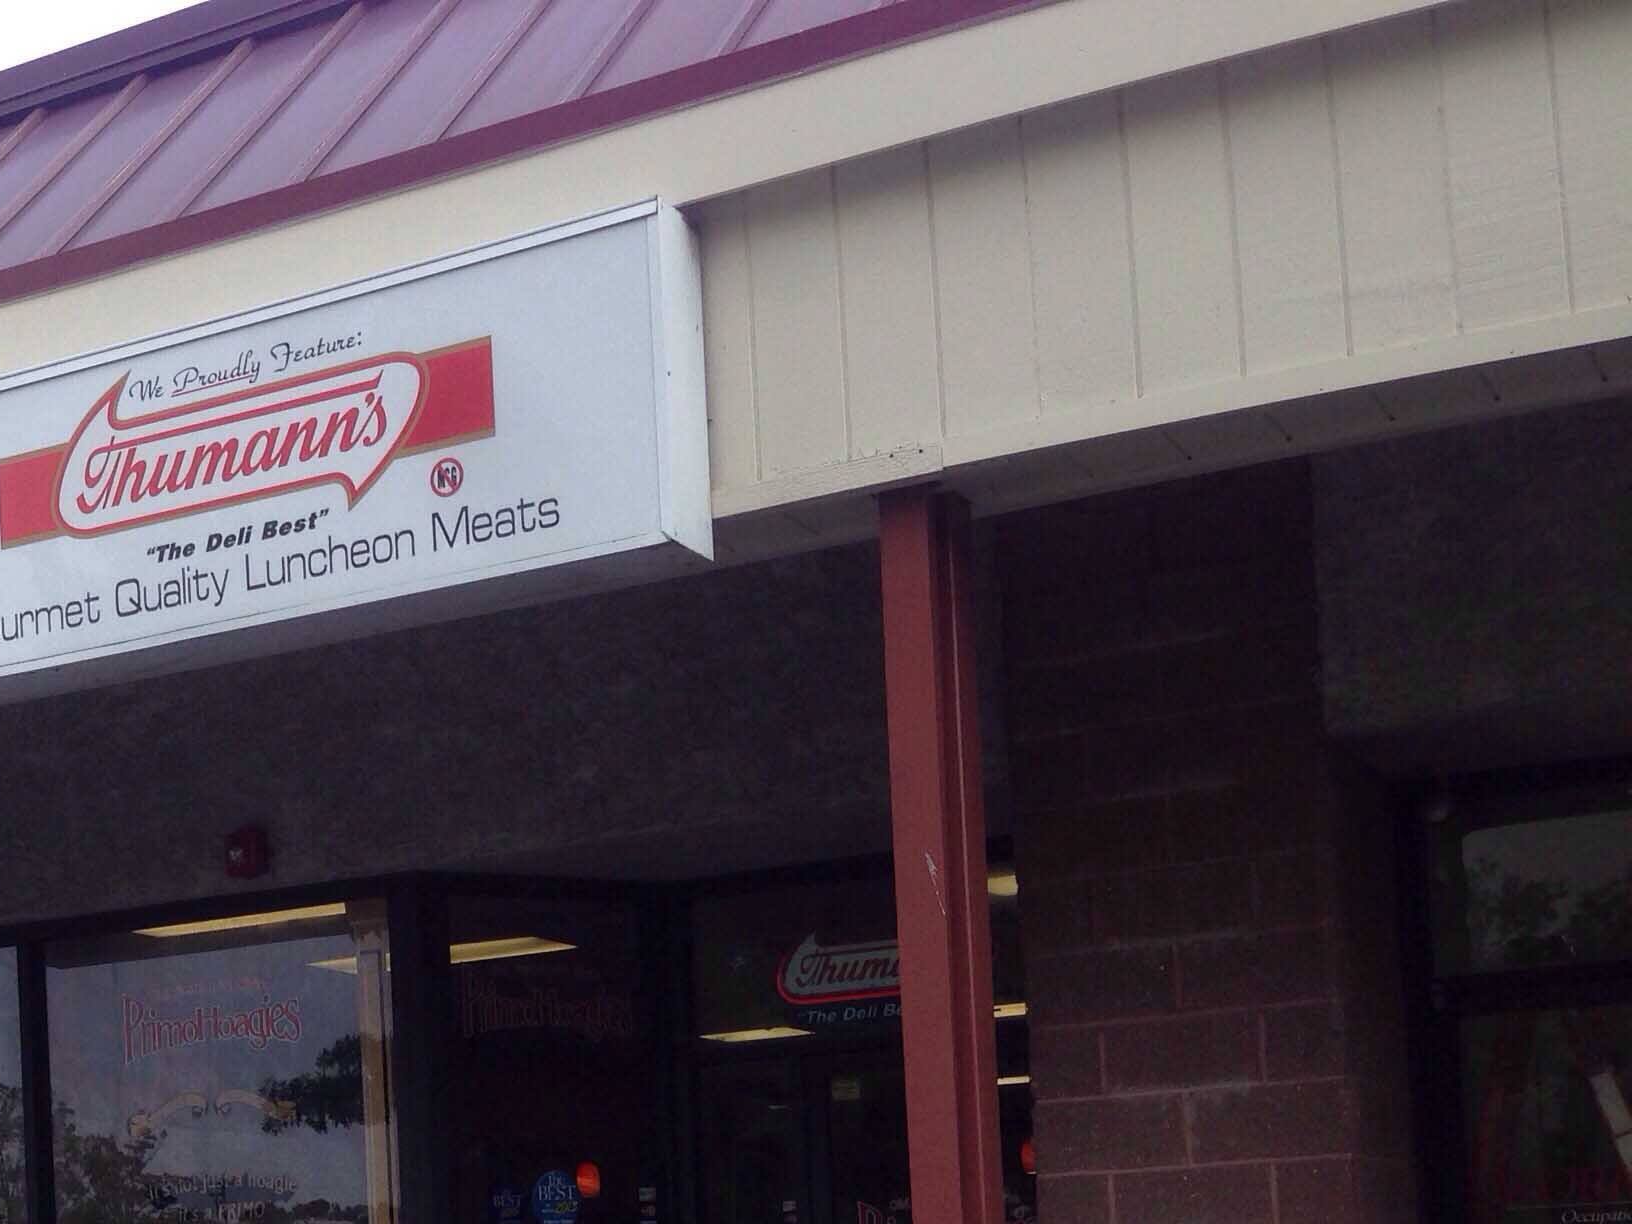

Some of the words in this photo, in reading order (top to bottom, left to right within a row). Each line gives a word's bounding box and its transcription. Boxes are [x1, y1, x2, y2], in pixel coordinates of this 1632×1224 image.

[129, 377, 164, 402] We
[172, 350, 261, 396] Proudly
[76, 374, 388, 514] Thumann's
[115, 565, 229, 616] Quality
[245, 525, 415, 591] Luncheon
[431, 495, 560, 552] Meats
[206, 526, 252, 554] Deli
